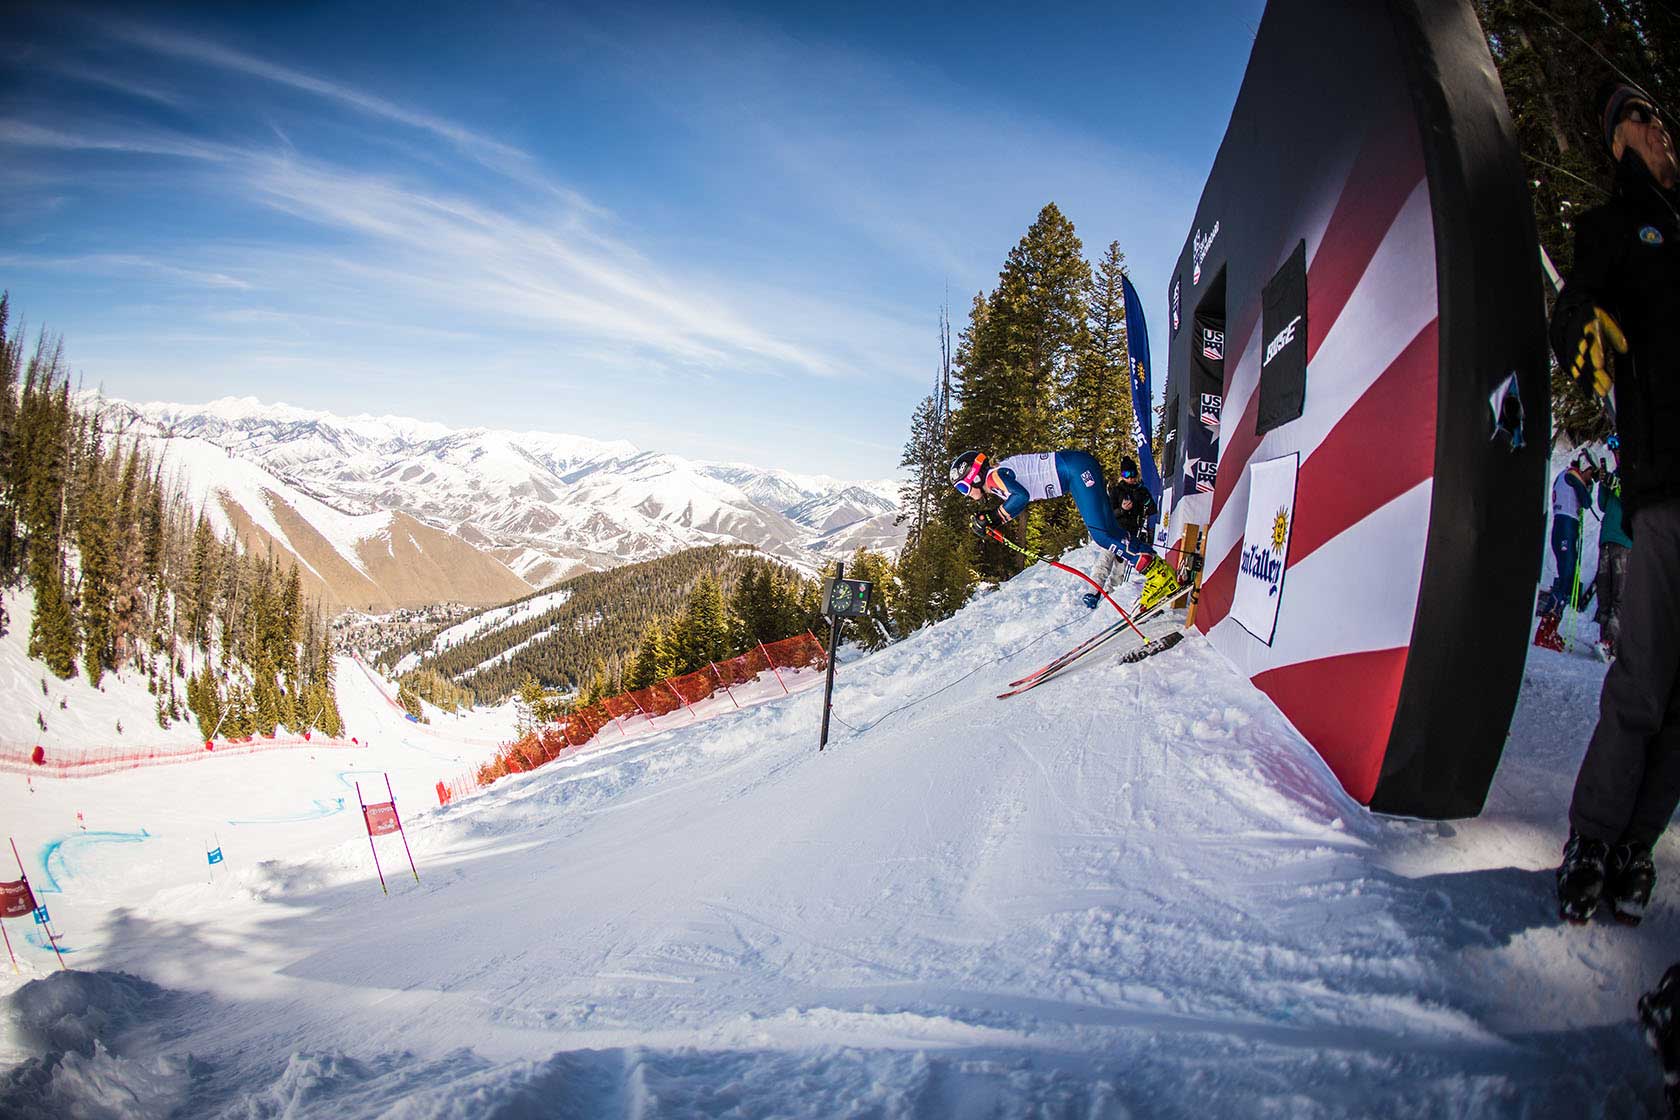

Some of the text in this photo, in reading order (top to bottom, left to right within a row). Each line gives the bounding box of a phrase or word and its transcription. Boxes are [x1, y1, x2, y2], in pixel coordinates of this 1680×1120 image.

[1204, 329, 1224, 342] US
[1201, 394, 1221, 408] US
[1199, 462, 1217, 474] US
[860, 601, 867, 613] 3
